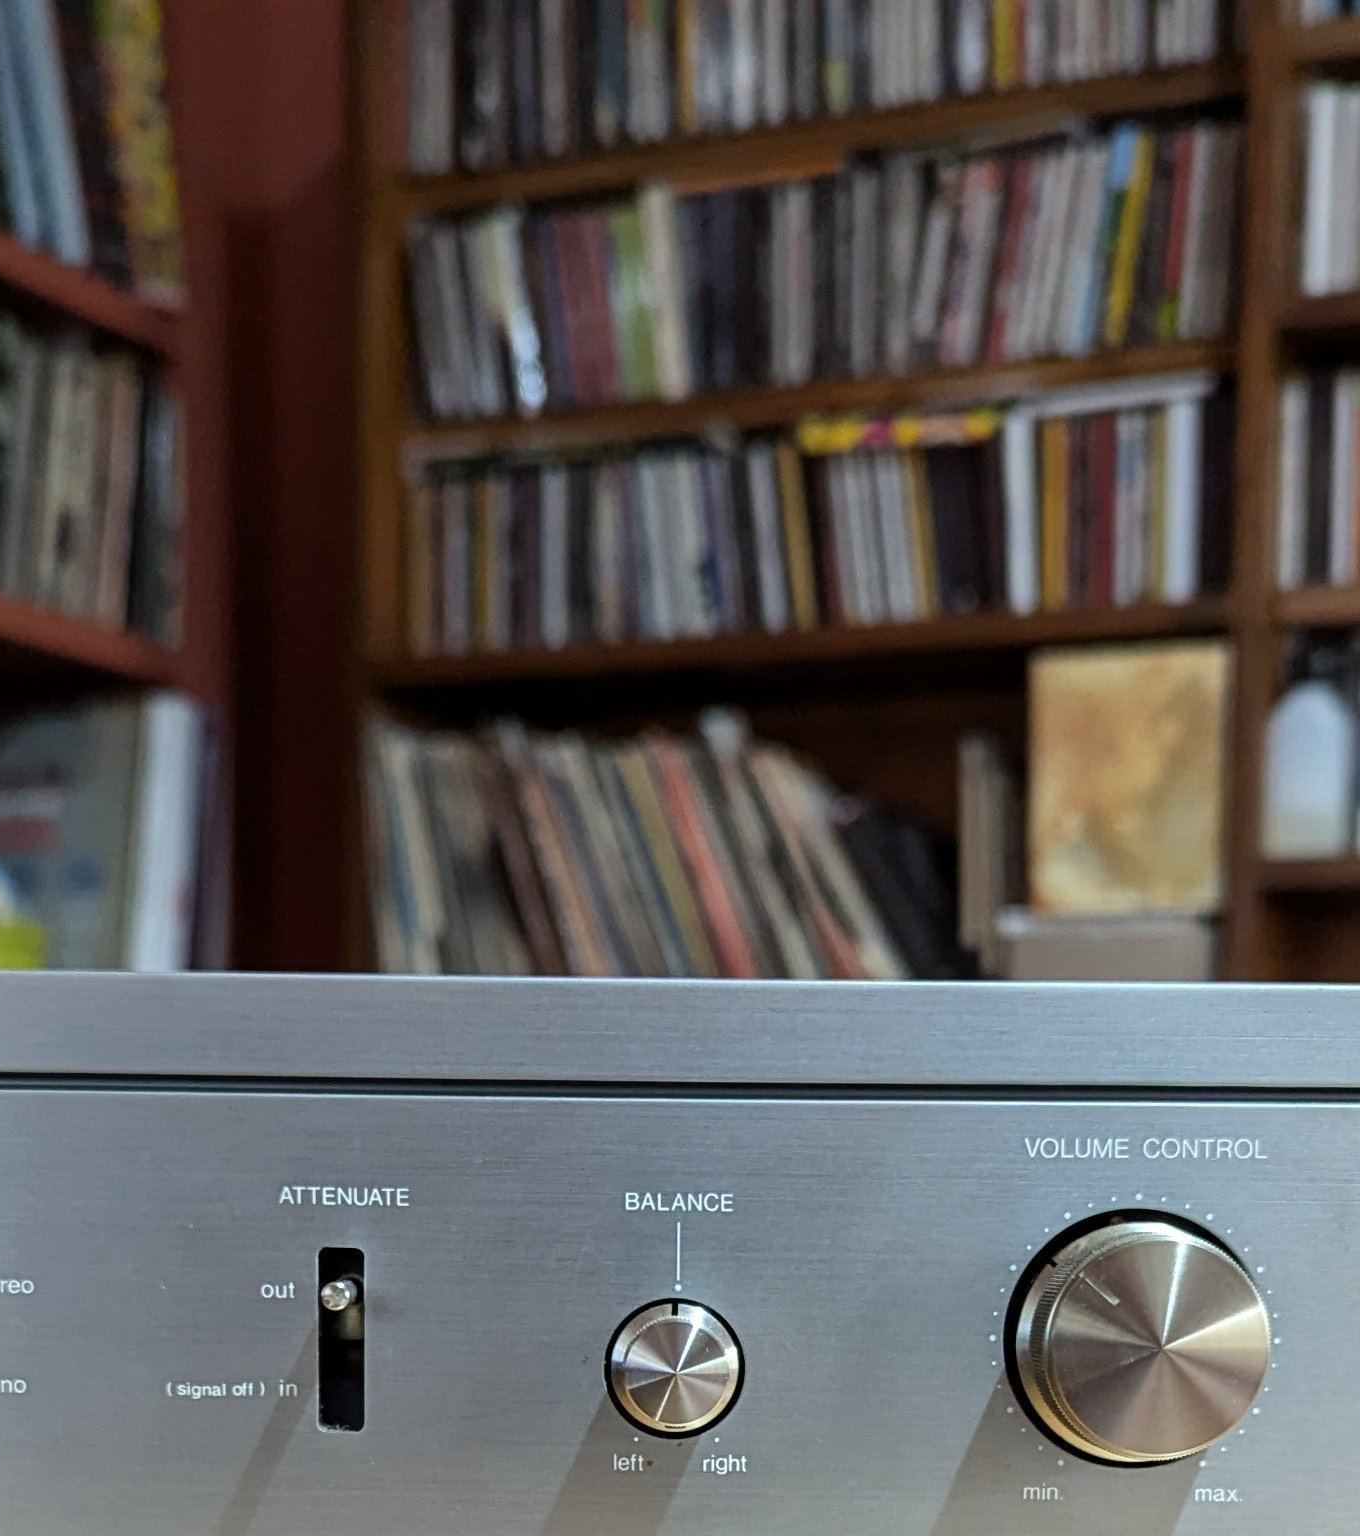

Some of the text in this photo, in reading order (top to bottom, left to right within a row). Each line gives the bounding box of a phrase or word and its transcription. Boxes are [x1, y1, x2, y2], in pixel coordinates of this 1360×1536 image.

[1024, 1137, 1268, 1160] VOLUME CONTROL
[279, 1186, 410, 1207] ATTENUATE
[624, 1192, 734, 1212] BALANCE
[260, 1281, 296, 1299] out
[278, 1379, 298, 1397] in
[613, 1453, 644, 1472] left
[702, 1454, 747, 1475] right
[1023, 1482, 1064, 1501] min.
[1194, 1486, 1244, 1502] max.
